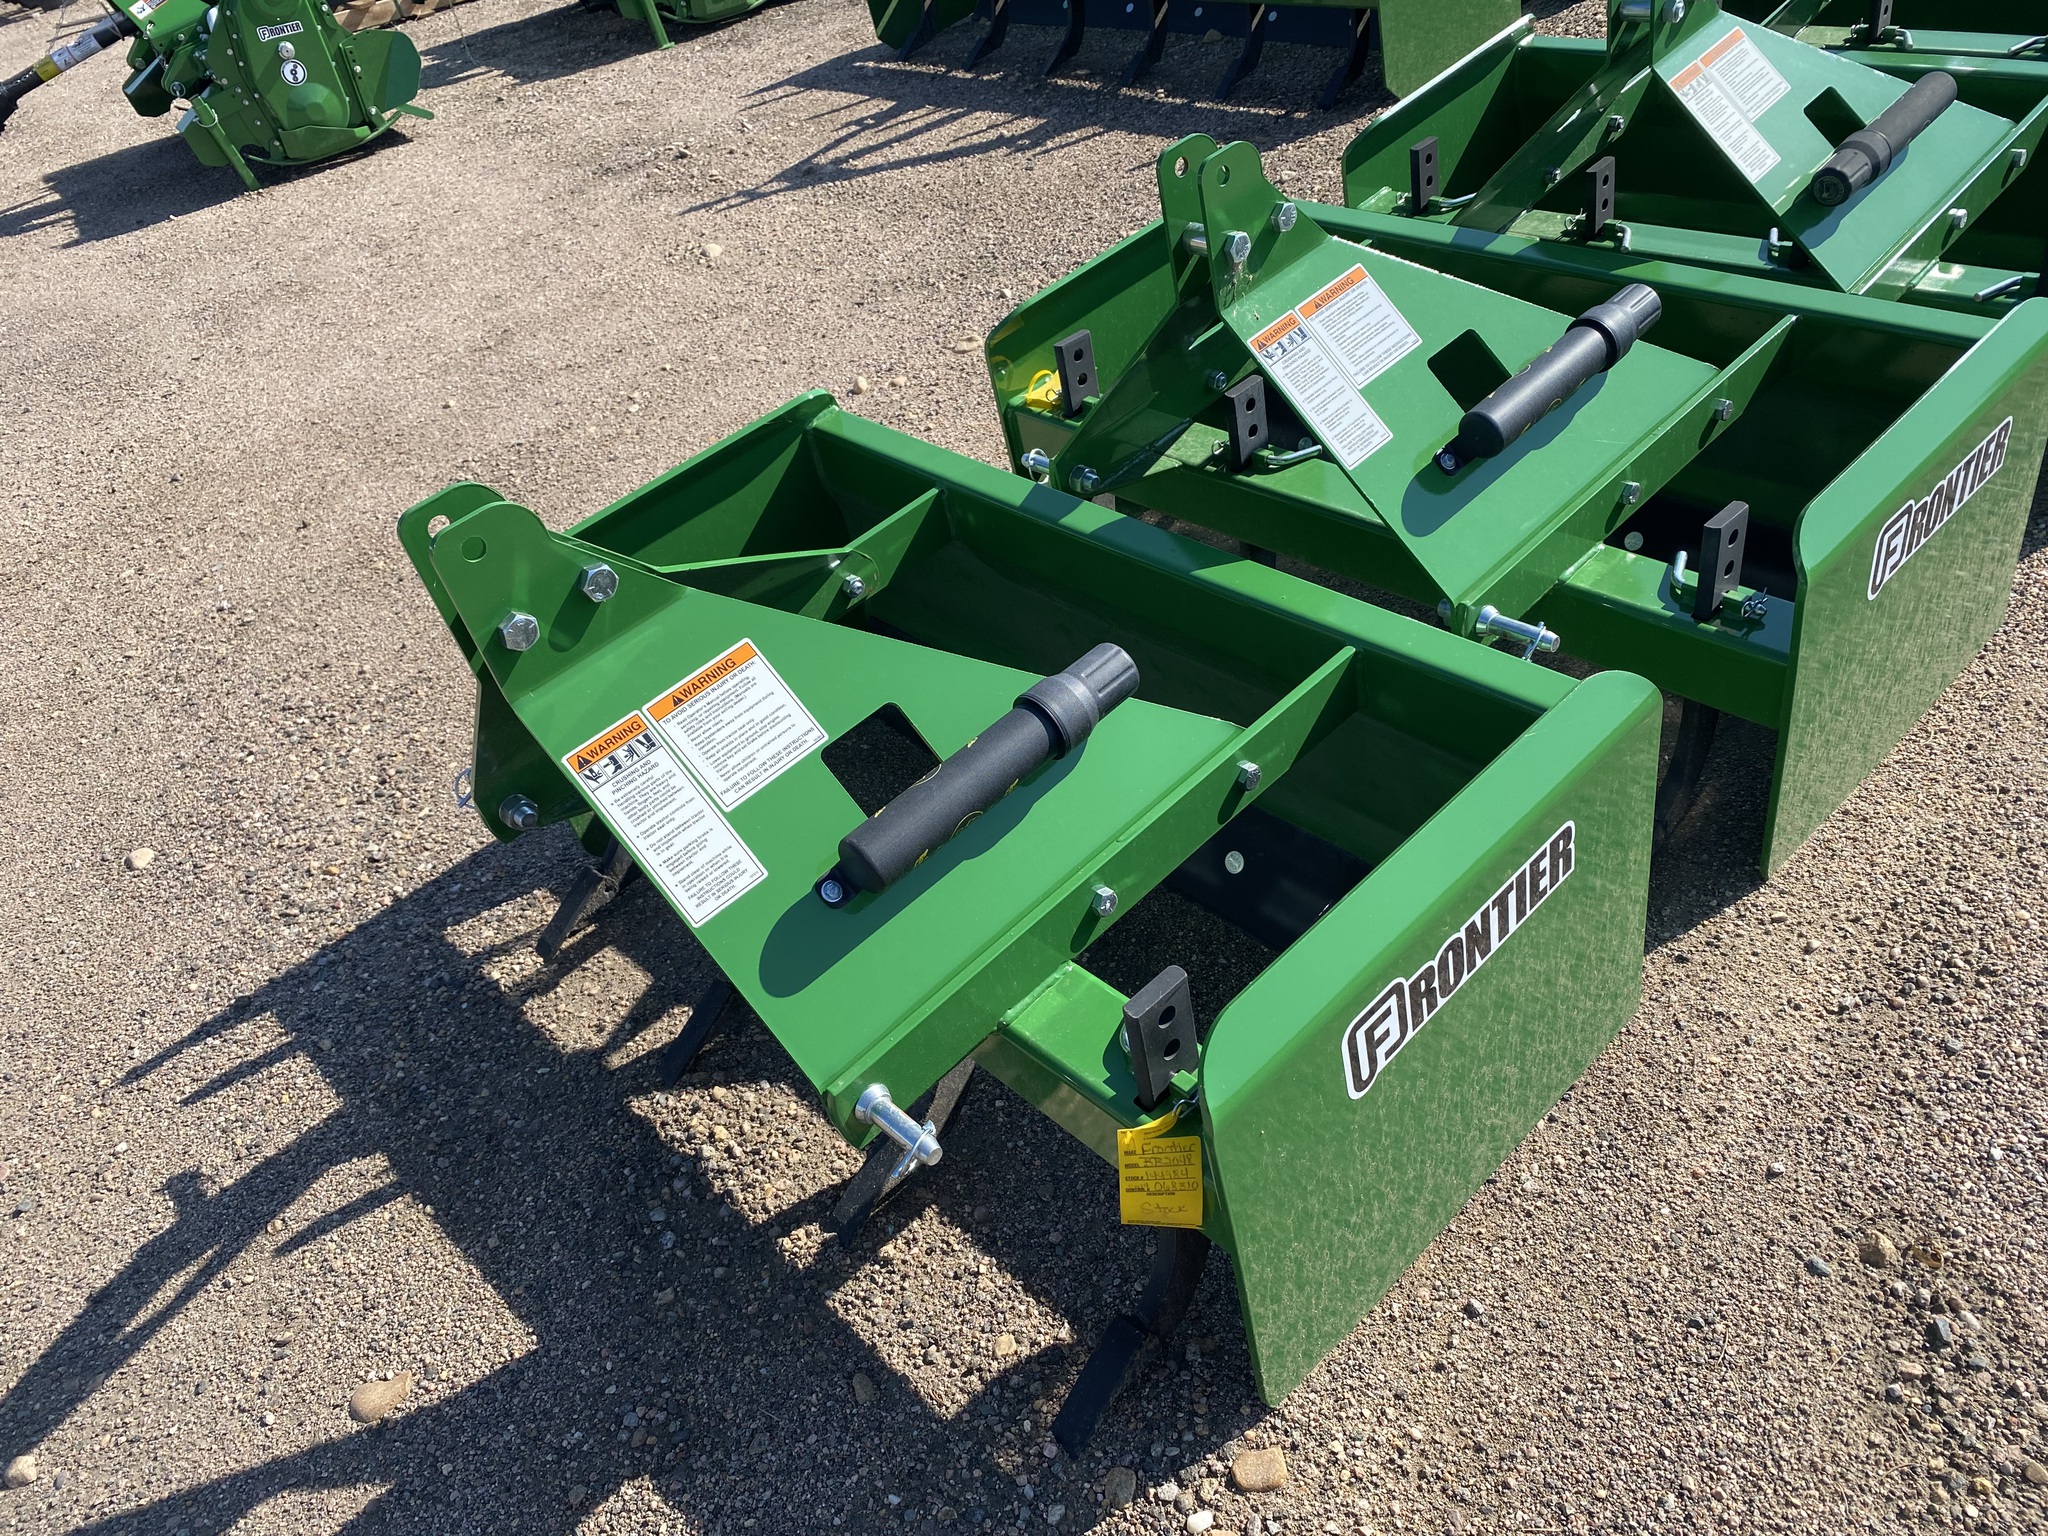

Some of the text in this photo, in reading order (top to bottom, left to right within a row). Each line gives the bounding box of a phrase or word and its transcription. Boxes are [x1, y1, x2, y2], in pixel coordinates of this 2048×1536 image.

[258, 22, 302, 40] FRONTIER
[1317, 276, 1354, 304] WARNING
[1262, 317, 1296, 343] WARNING
[1871, 420, 2011, 595] FRONTIER
[670, 706, 687, 720] AVOID
[686, 690, 711, 708] SERIOUS
[709, 678, 729, 693] INJURY
[728, 672, 738, 680] OR
[680, 658, 736, 698] WARNING
[585, 720, 641, 758] WARNING
[611, 759, 651, 787] CRUSHING AND
[611, 761, 659, 795] PINCHING HAZARD
[719, 780, 740, 796] FAILURE
[746, 760, 767, 776] FOLLOW
[766, 749, 782, 762] THESE
[781, 726, 814, 751] INSTRUCTIONS
[733, 784, 745, 793] CAN
[744, 770, 762, 786] RESULT
[767, 755, 784, 769] INJURY
[687, 885, 705, 900] FAILURE
[710, 868, 728, 883] FOLLOW
[728, 859, 742, 870] THESE
[694, 894, 711, 908] RESULT
[715, 878, 734, 893] SERIOUS
[733, 868, 748, 880] INJURY
[696, 877, 726, 900] INSTRUCTIONS
[725, 867, 740, 879] COULD
[1348, 826, 1572, 1092] FRONTIER
[1140, 1202, 1188, 1214] Stock
